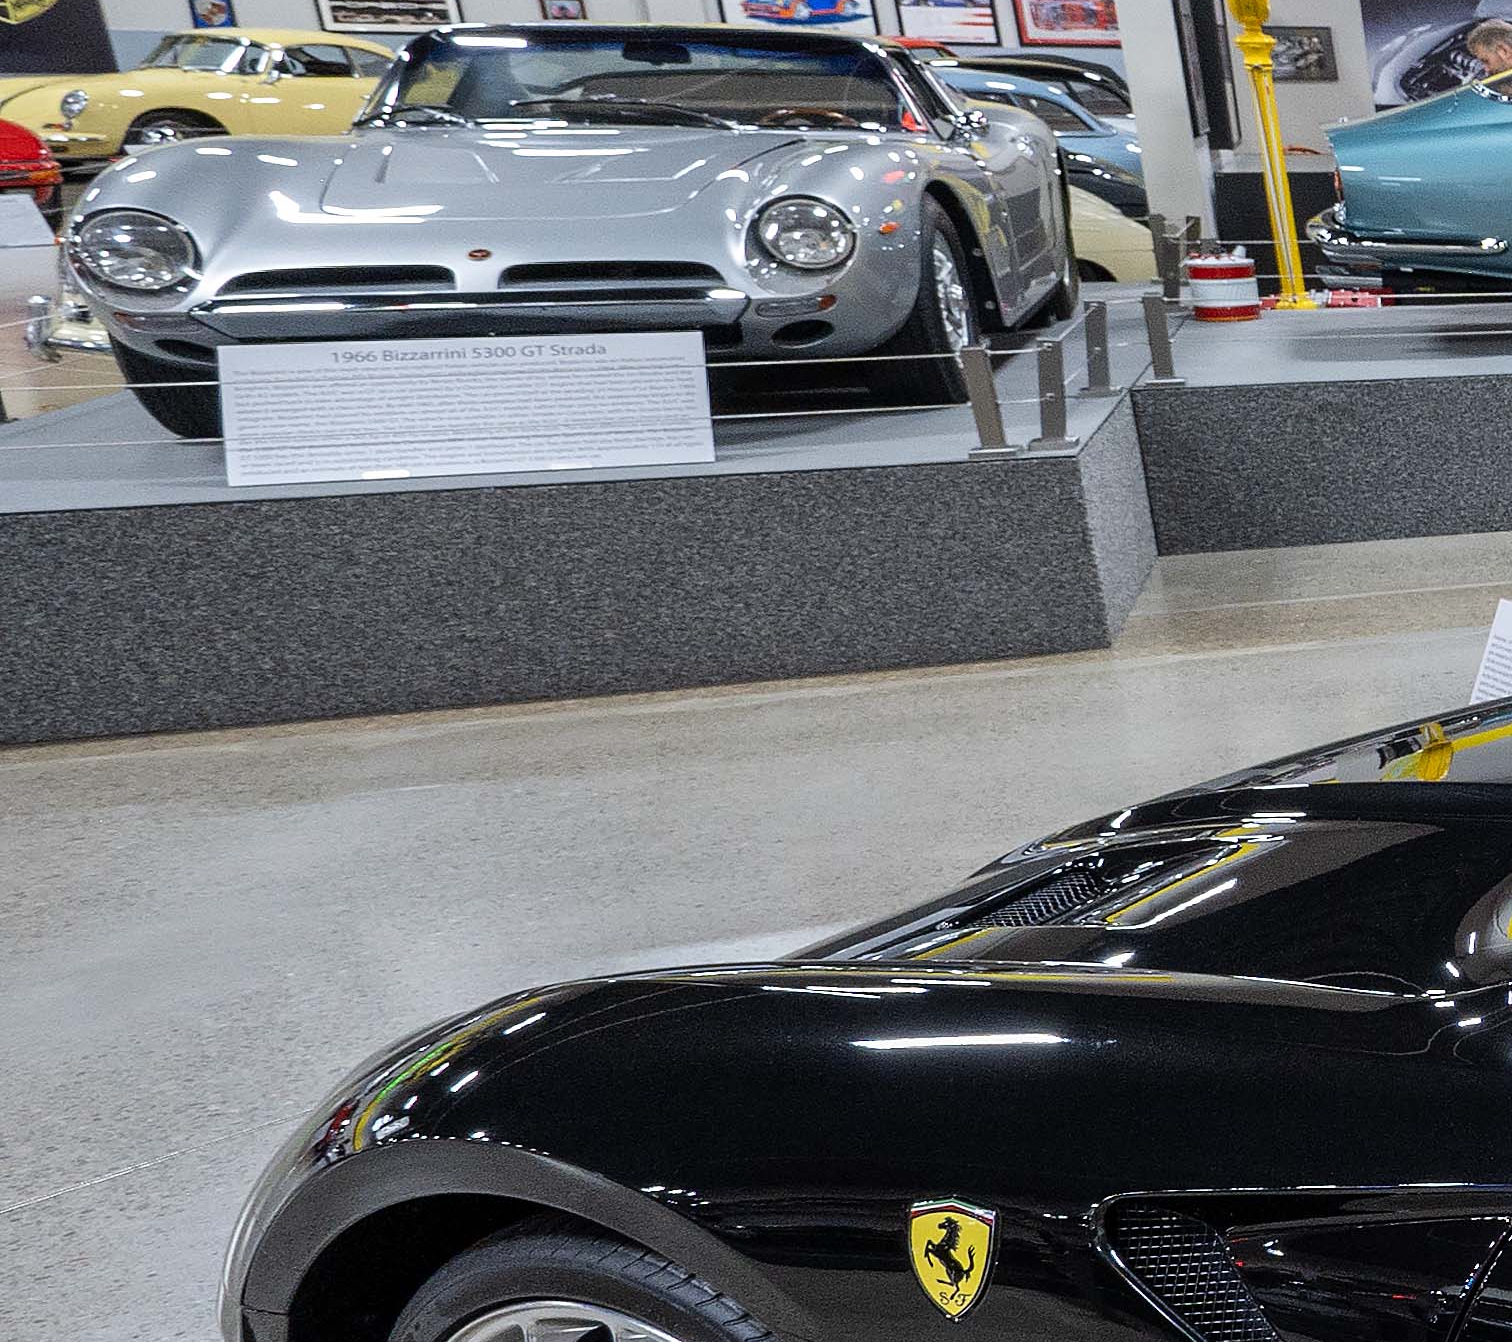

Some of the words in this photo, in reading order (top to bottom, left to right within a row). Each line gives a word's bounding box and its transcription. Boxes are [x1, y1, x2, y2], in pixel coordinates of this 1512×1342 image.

[331, 350, 377, 364] 1966
[382, 348, 467, 361] Bizzarrini
[471, 347, 517, 359] 5300
[522, 345, 545, 357] GT
[550, 343, 607, 356] Strada
